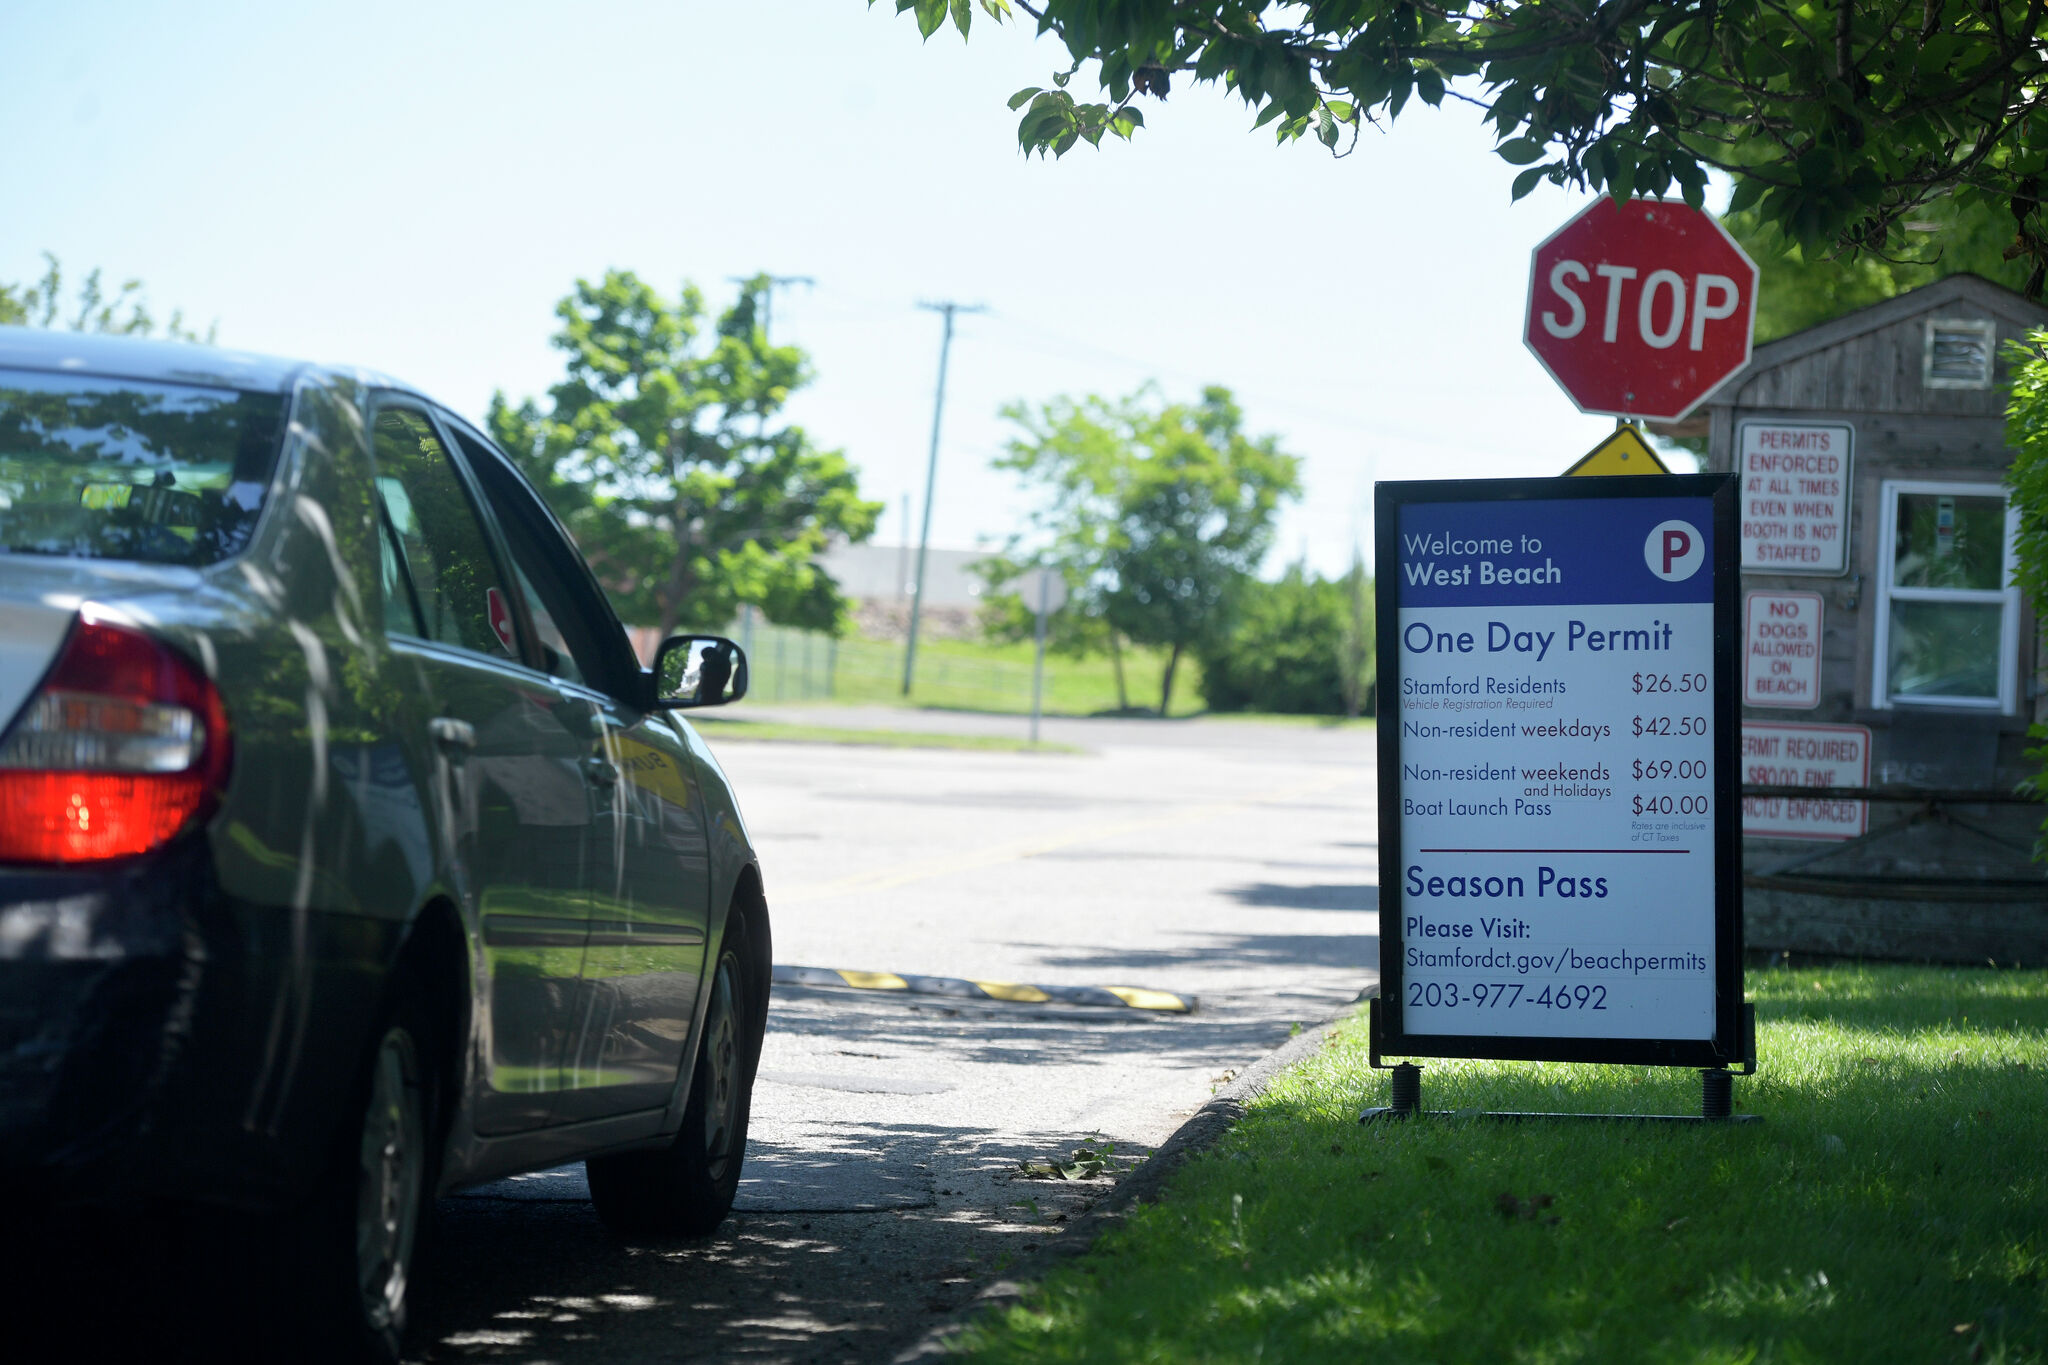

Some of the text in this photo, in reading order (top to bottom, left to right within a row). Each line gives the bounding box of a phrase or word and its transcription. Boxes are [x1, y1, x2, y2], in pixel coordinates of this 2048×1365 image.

[1542, 259, 1740, 351] STOP
[1760, 431, 1831, 451] PERMITS
[1748, 454, 1840, 474] ENFORCED
[1748, 478, 1840, 496] AT ALL TIMES
[1751, 501, 1834, 518] EVEN WHEN
[1742, 522, 1838, 541] BOOTH IS NOT
[1404, 531, 1542, 556] Welcome to
[1662, 530, 1691, 574] P
[1756, 544, 1821, 563] STAFFED
[1404, 558, 1562, 586] West Beach
[1769, 602, 1799, 618] NO
[1404, 620, 1673, 662] One Day Permit
[1759, 623, 1808, 639] DOGS
[1752, 642, 1815, 658] ALLOWED
[1771, 661, 1792, 675] ON
[1403, 672, 1707, 695] Stamford Residents $26.50
[1756, 679, 1808, 694] BEACH
[1403, 697, 1554, 712] Vehicle Registration Required
[1404, 715, 1707, 742] Non-resident weekdays $42.50
[1742, 735, 1859, 762] ERMIT REQUIRED
[1404, 758, 1707, 781] Non-resident weekends $69.00
[1524, 783, 1611, 800] and Holidays
[1404, 794, 1708, 816] Boat Launch Pass $40.00
[1787, 797, 1857, 823] ENFORCED
[1632, 821, 1706, 831] Rates are inclusive
[1632, 833, 1680, 842] of CT Taxes
[1406, 865, 1608, 898] Season Pass
[1407, 915, 1531, 939] Please Visit:
[1407, 946, 1706, 975] Stamfordct.gov/beachpermits
[1408, 982, 1607, 1010] 203-977-4692
